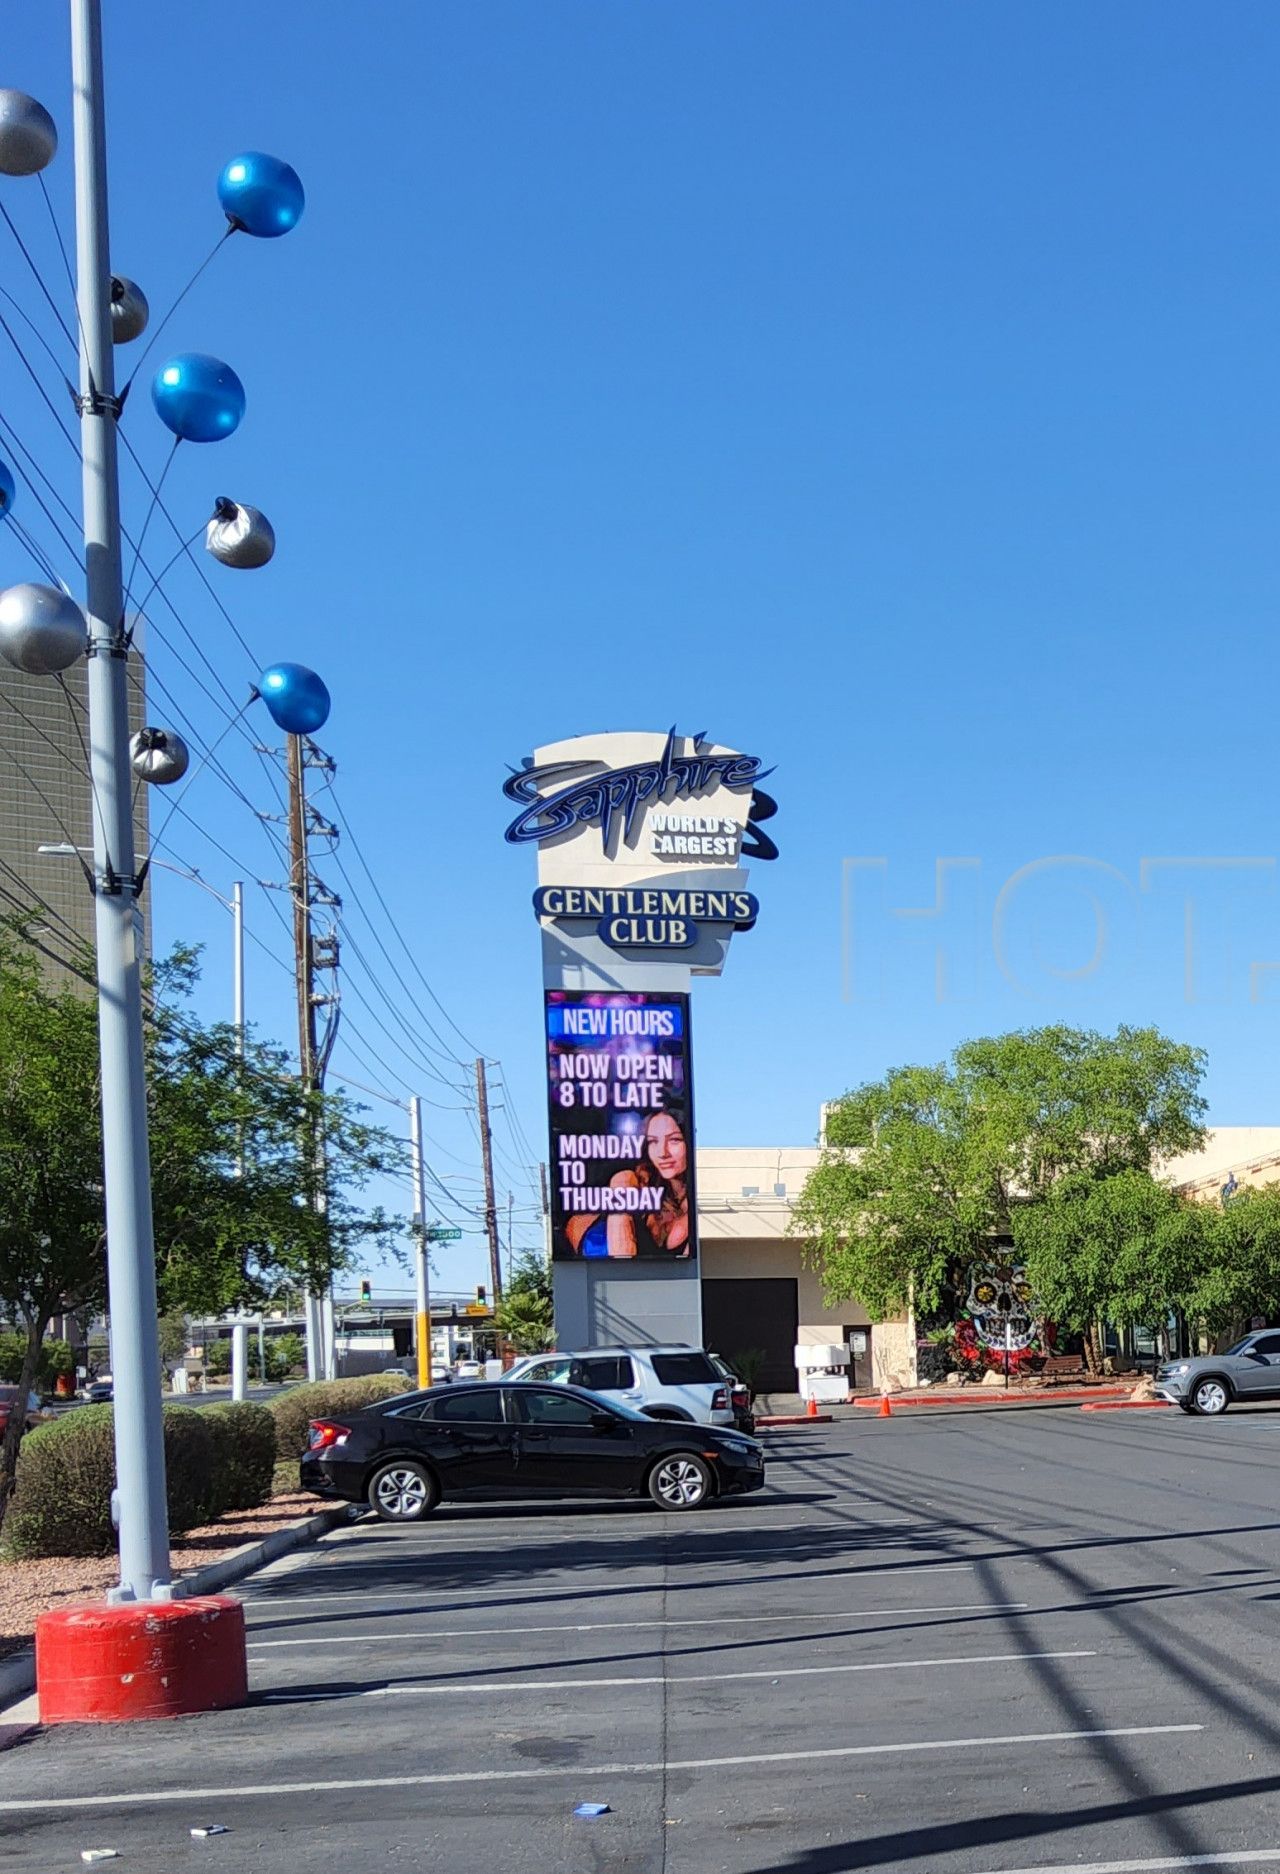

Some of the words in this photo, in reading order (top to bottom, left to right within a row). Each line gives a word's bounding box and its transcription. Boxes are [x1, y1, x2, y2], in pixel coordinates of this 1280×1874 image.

[502, 724, 778, 852] Sapphire
[650, 814, 738, 835] WORLD'S
[650, 834, 738, 856] LARGEST
[542, 889, 751, 918] GENTLEMEN'S
[609, 918, 688, 944] CLUB
[563, 1008, 607, 1035] NEW
[610, 1010, 674, 1036] HOURS
[559, 1054, 610, 1079] NOW
[616, 1055, 673, 1080] OPEN
[559, 1082, 575, 1107] 8
[580, 1082, 607, 1107] TO
[613, 1082, 664, 1108] LATE
[559, 1134, 646, 1159] MONDAY
[558, 1161, 586, 1185] TO
[559, 1187, 665, 1211] THURSDAY
